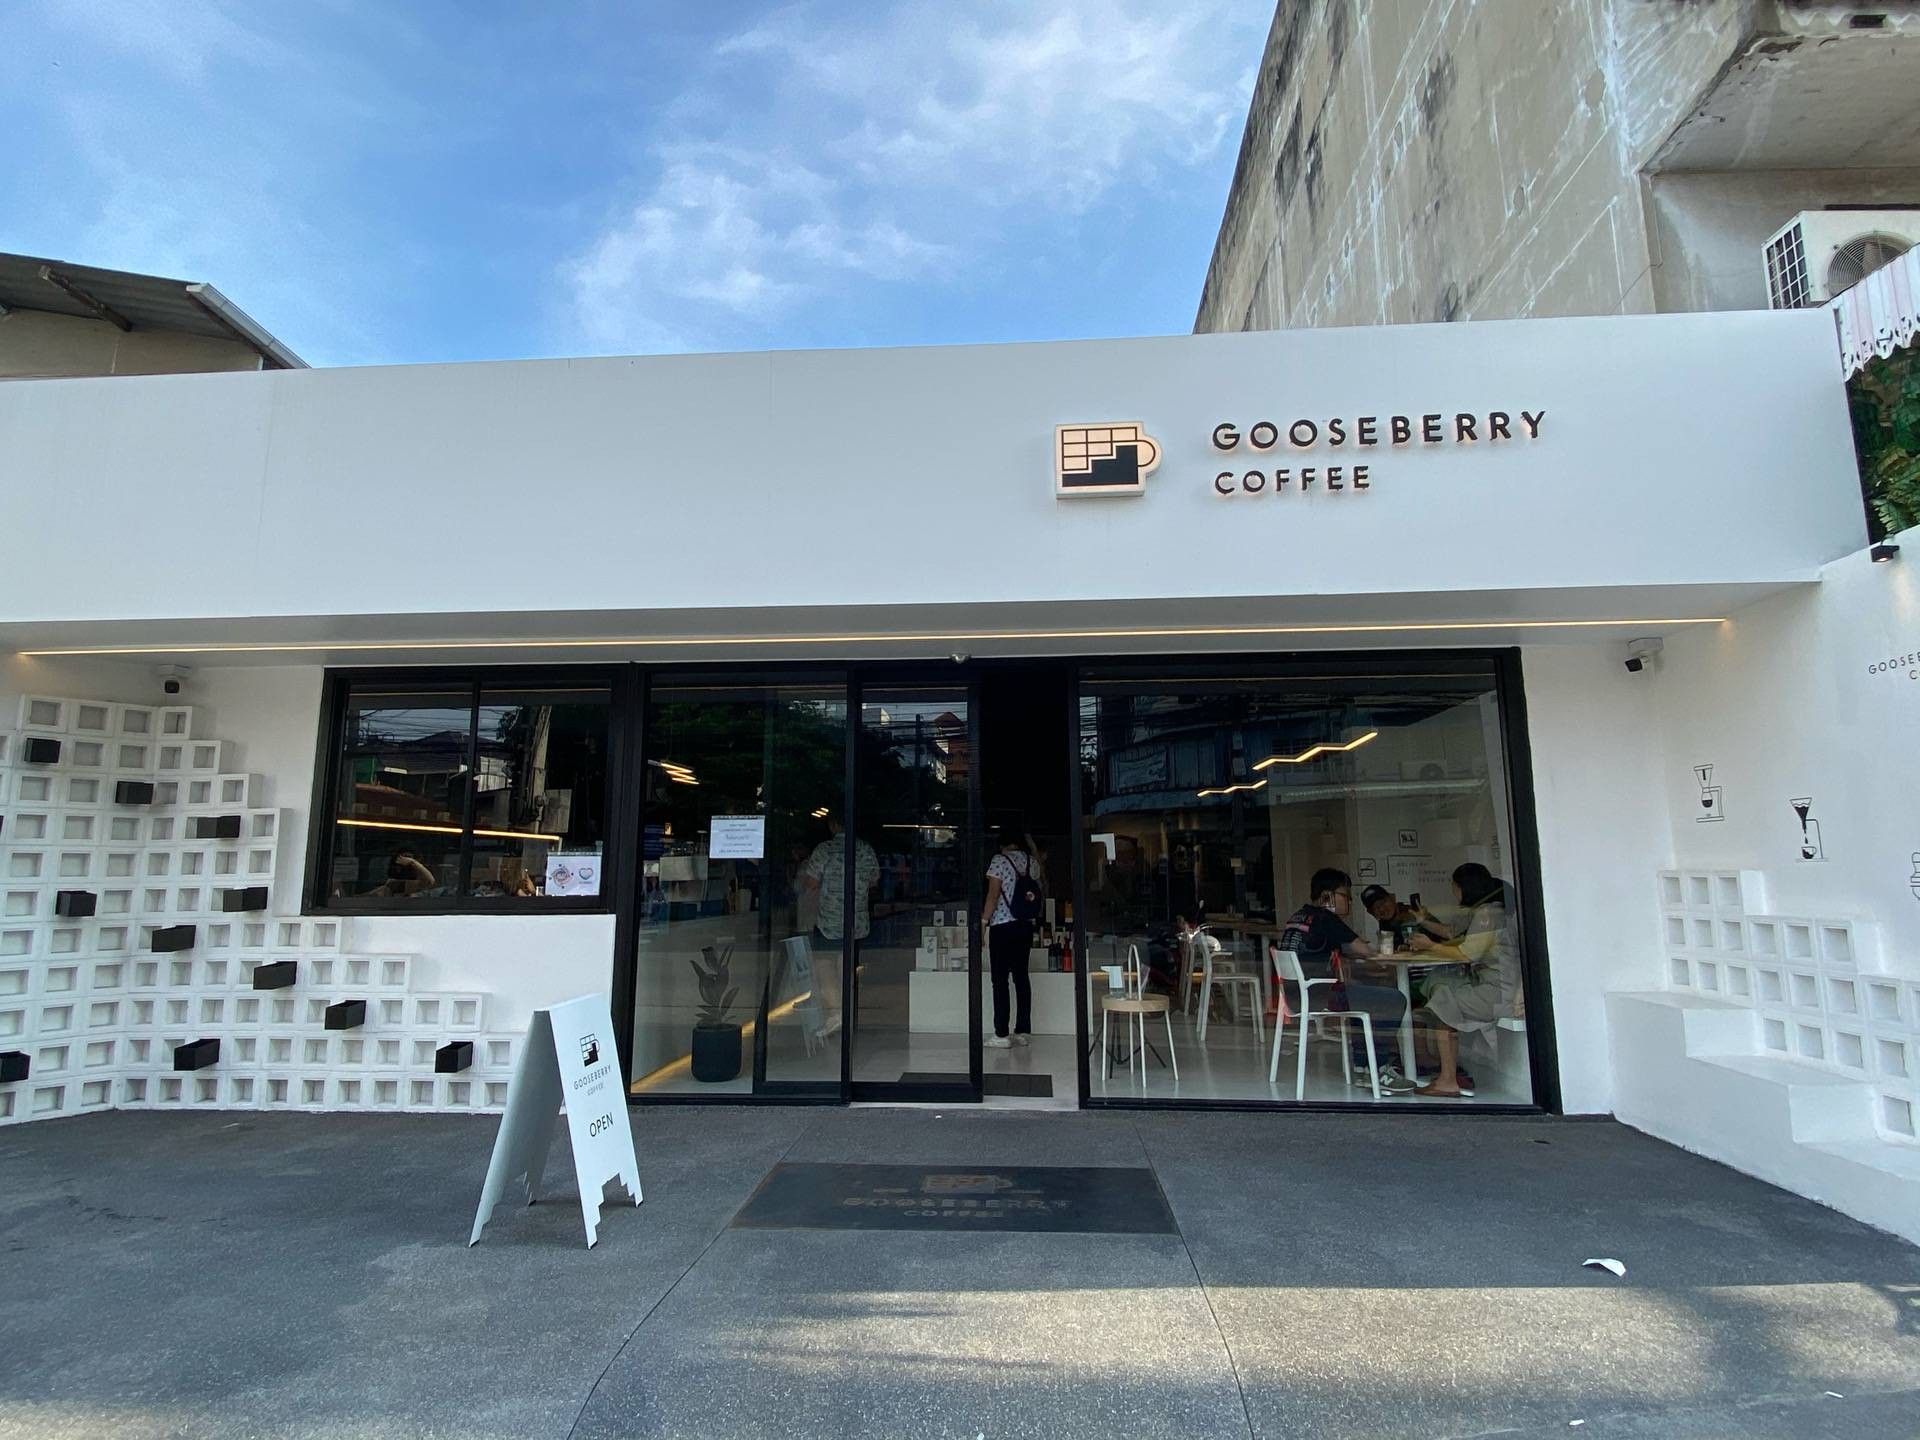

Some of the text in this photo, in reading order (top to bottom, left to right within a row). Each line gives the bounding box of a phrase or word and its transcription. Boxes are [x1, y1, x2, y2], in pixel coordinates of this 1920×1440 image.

[1212, 411, 1546, 450] GOOSEBERRY
[1214, 465, 1370, 495] COFFEE
[573, 1064, 611, 1090] GOOSEBERRY
[589, 1112, 614, 1138] OPEN
